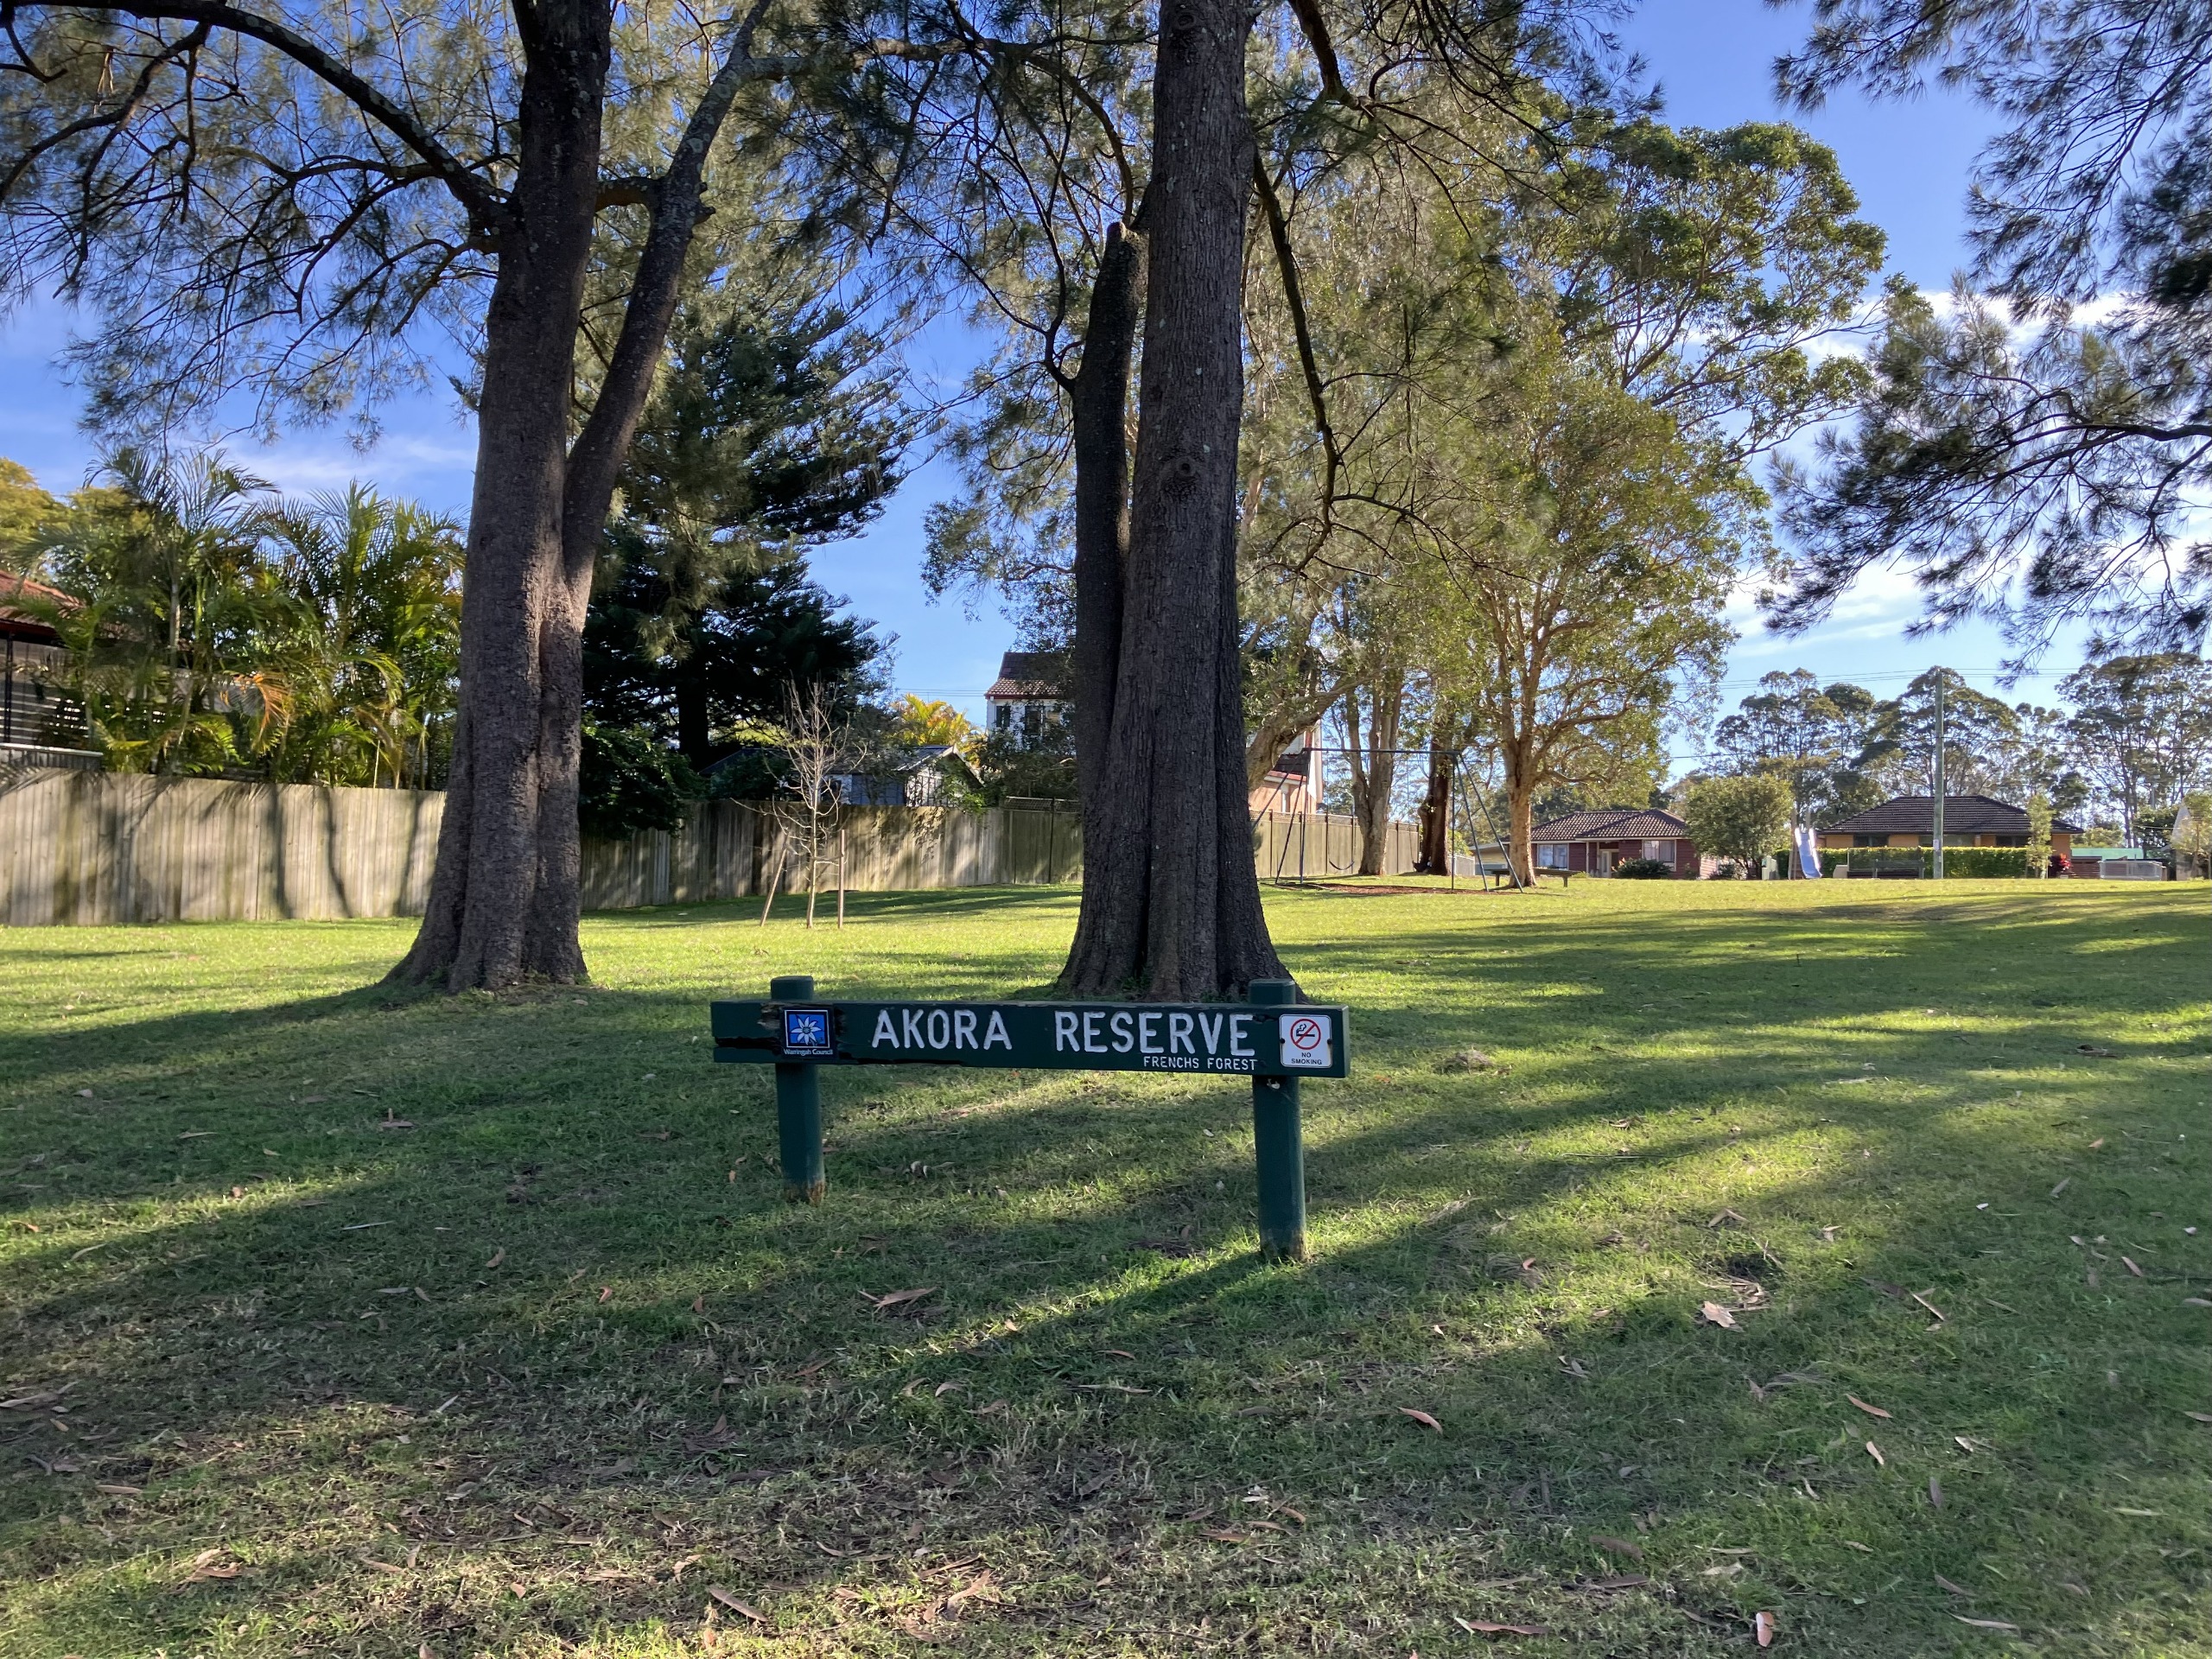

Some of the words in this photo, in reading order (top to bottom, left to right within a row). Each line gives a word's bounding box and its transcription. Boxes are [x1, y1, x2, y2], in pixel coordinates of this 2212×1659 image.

[872, 1008, 1013, 1050] AKORA
[1054, 1010, 1255, 1056] RESERVE
[1143, 1056, 1199, 1069] FRENCHS
[1207, 1058, 1258, 1071] FOREST
